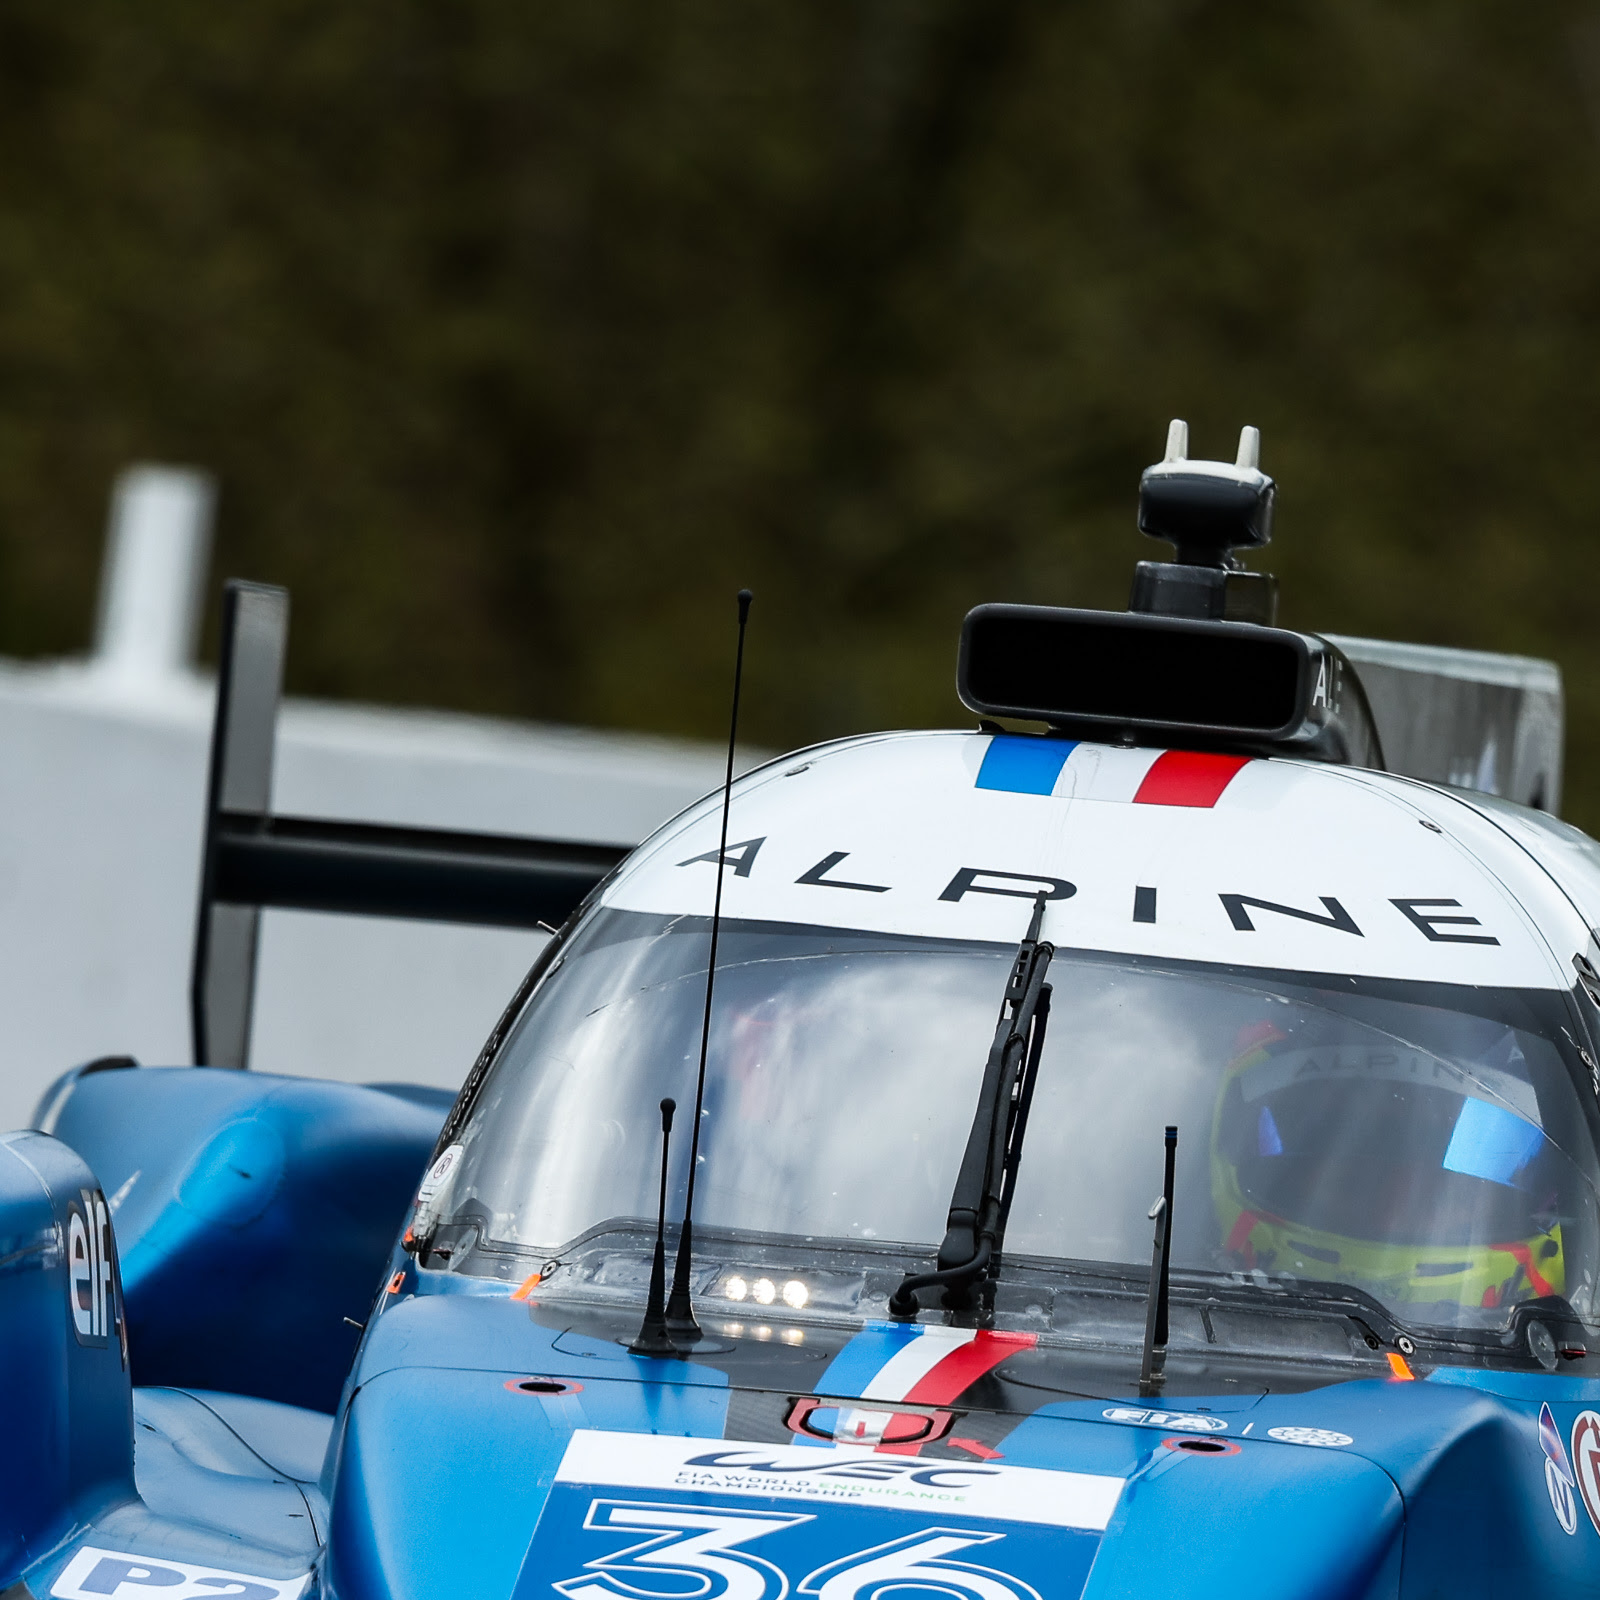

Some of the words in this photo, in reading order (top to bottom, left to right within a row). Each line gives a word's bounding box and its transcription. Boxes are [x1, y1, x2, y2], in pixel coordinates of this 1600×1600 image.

[674, 835, 1502, 947] ALPINE
[69, 1192, 111, 1337] elf
[673, 1477, 863, 1499] CHAMPIONSHIP
[677, 1471, 721, 1481] FIA
[725, 1473, 811, 1488] WORLD
[818, 1481, 968, 1502] ENDURANCE
[683, 1450, 1003, 1488] WEC
